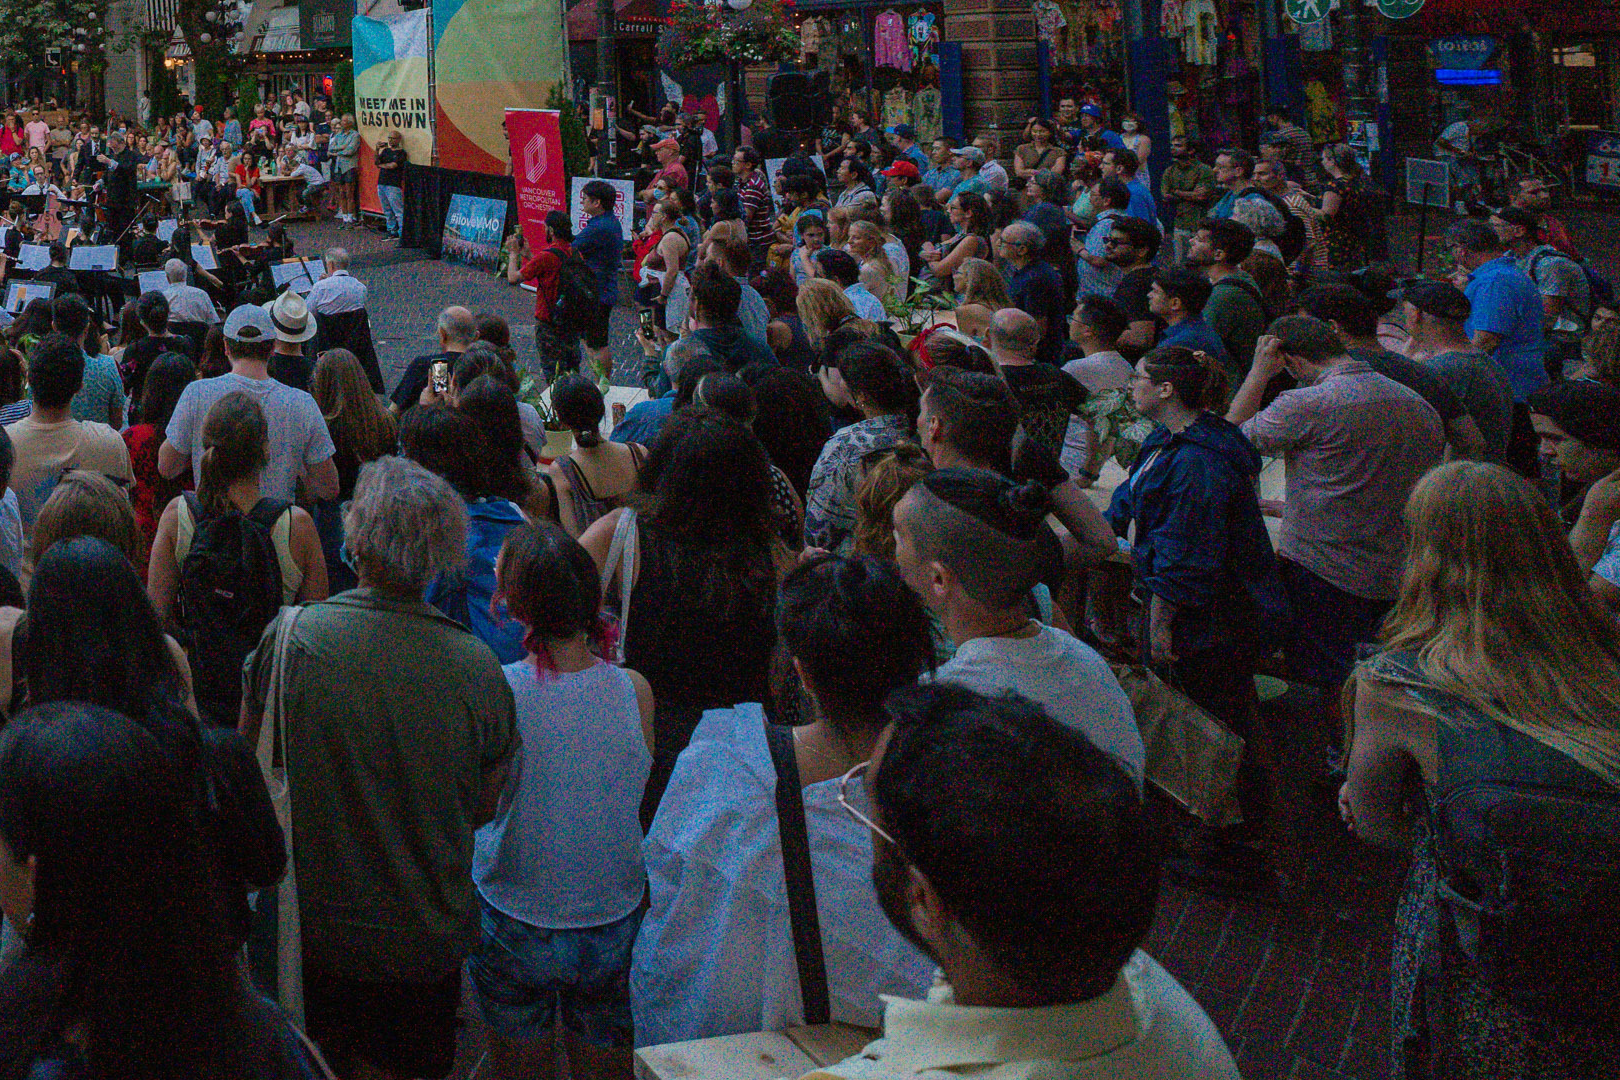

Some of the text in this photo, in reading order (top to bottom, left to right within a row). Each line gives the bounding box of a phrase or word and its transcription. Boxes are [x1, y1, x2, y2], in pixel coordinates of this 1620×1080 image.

[619, 22, 653, 33] Carrall
[359, 97, 426, 111] MEET ME IN
[361, 110, 426, 129] GASTOWN
[521, 186, 556, 198] VANCOUVER
[519, 193, 561, 206] METROPOLITAN
[450, 212, 499, 232] #iloveVMO
